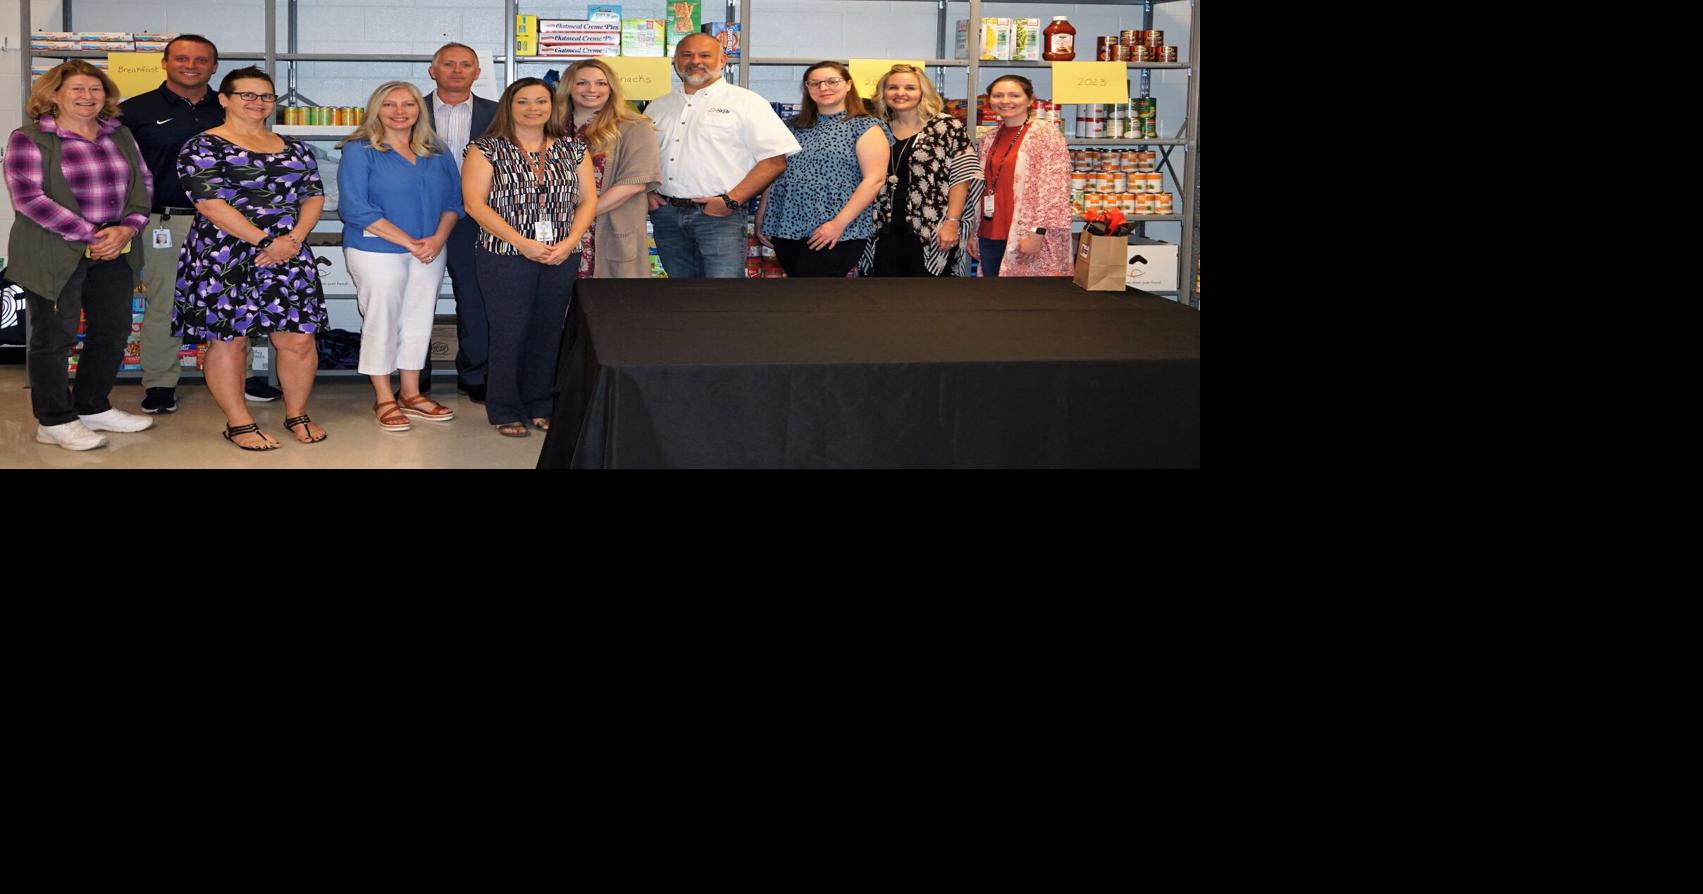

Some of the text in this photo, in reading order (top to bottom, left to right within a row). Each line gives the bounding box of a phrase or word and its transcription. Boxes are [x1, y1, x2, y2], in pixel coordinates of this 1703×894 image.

[554, 34, 582, 42] Oatmeal
[117, 64, 160, 74] Breakfast
[619, 73, 652, 83] nacks
[1077, 77, 1108, 87] 2023
